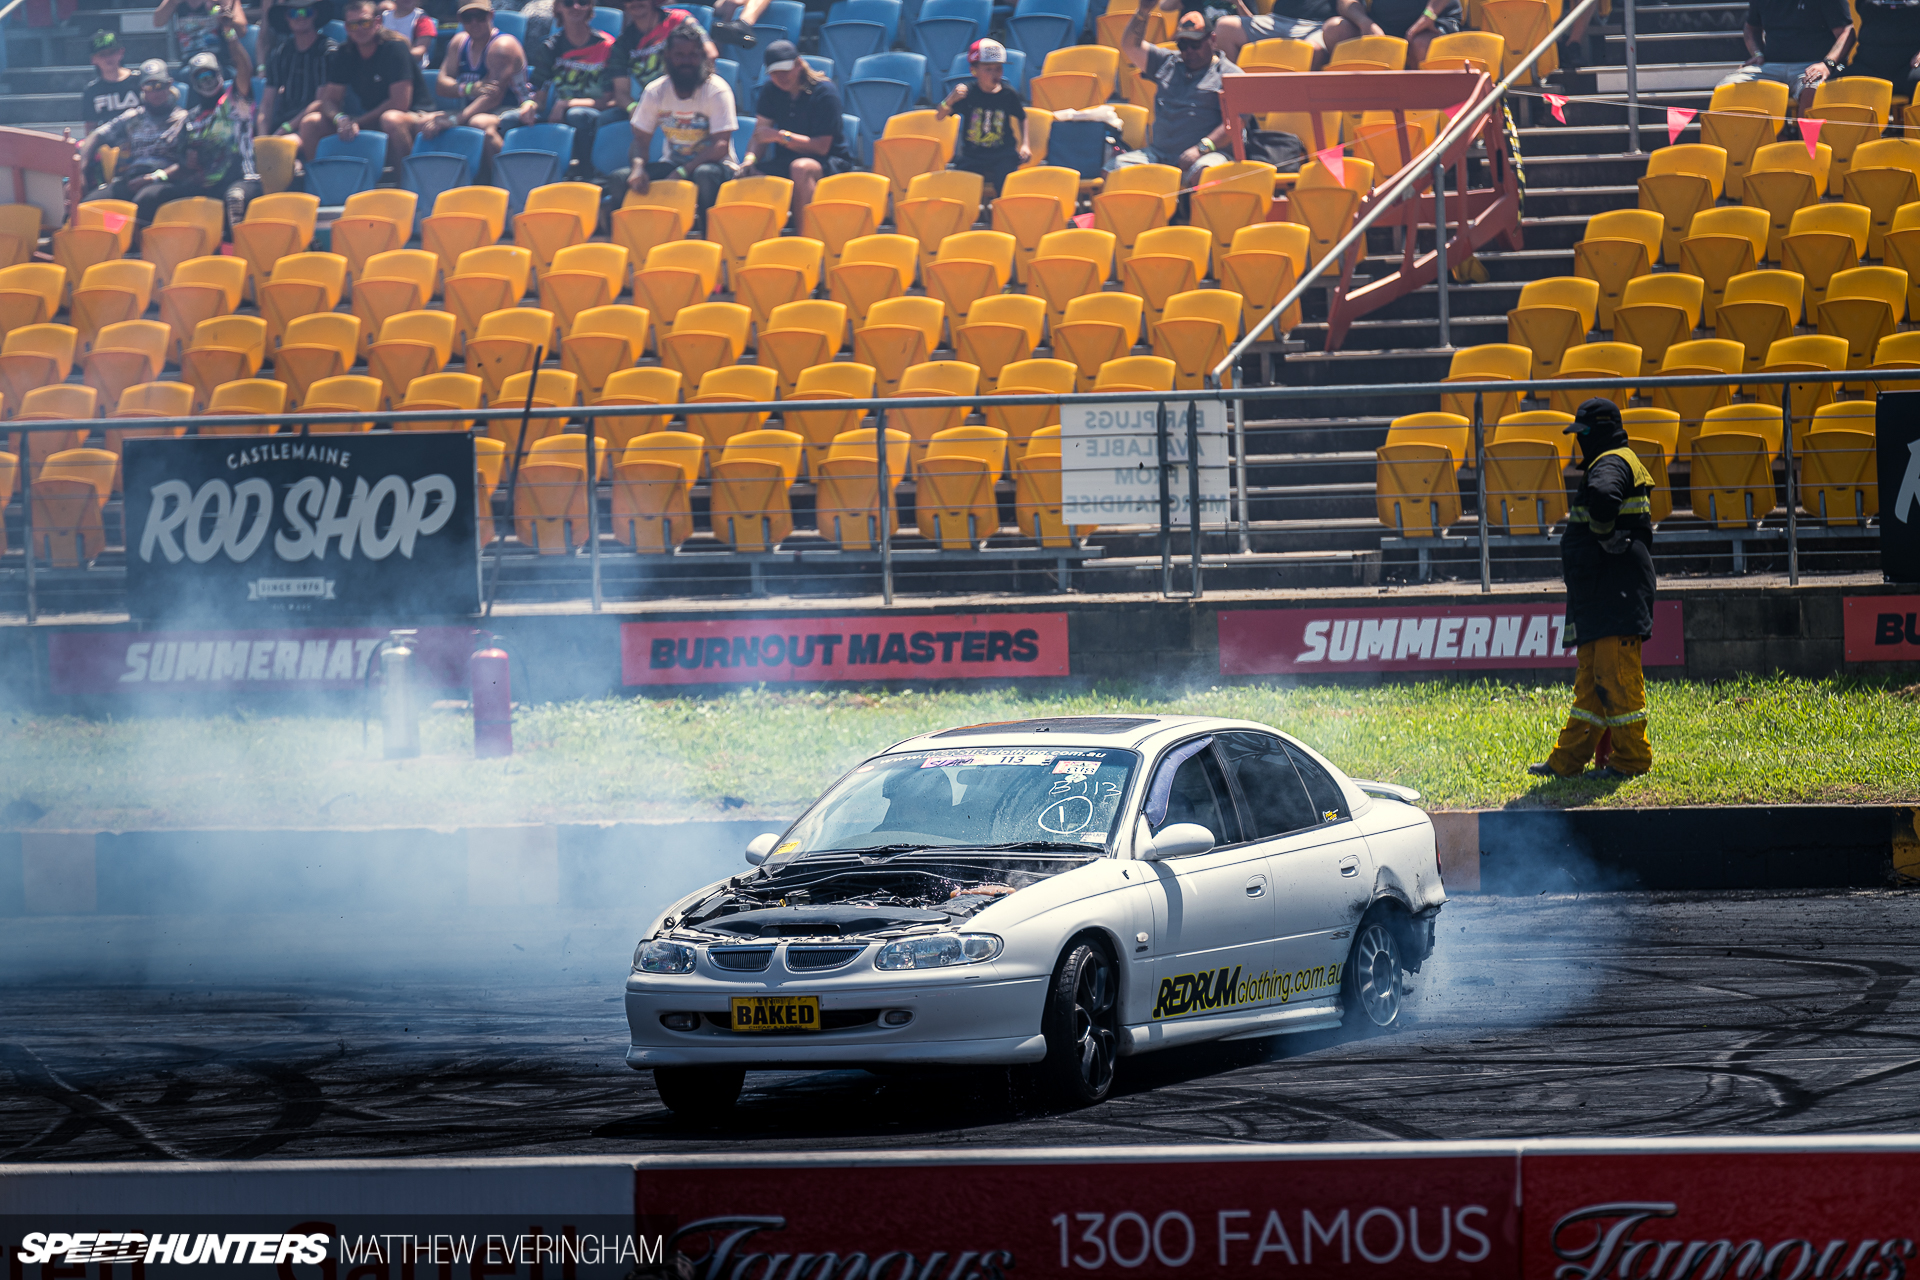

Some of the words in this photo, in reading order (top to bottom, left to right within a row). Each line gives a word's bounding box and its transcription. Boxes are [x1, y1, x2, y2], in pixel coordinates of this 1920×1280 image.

[93, 90, 140, 113] FILA
[227, 443, 351, 469] CASTLEMAINE
[140, 478, 273, 563] ROD
[275, 473, 456, 561] SHOP
[119, 639, 392, 682] SUMMERNAT
[650, 634, 842, 669] BURNOUT
[847, 628, 1039, 664] MASTERS
[1294, 614, 1577, 664] SUMMERNAT
[737, 1005, 815, 1025] BAKED
[1051, 1211, 1196, 1269] 1300
[1218, 1205, 1492, 1265] FAMOUS
[1551, 1202, 1917, 1280] Famous
